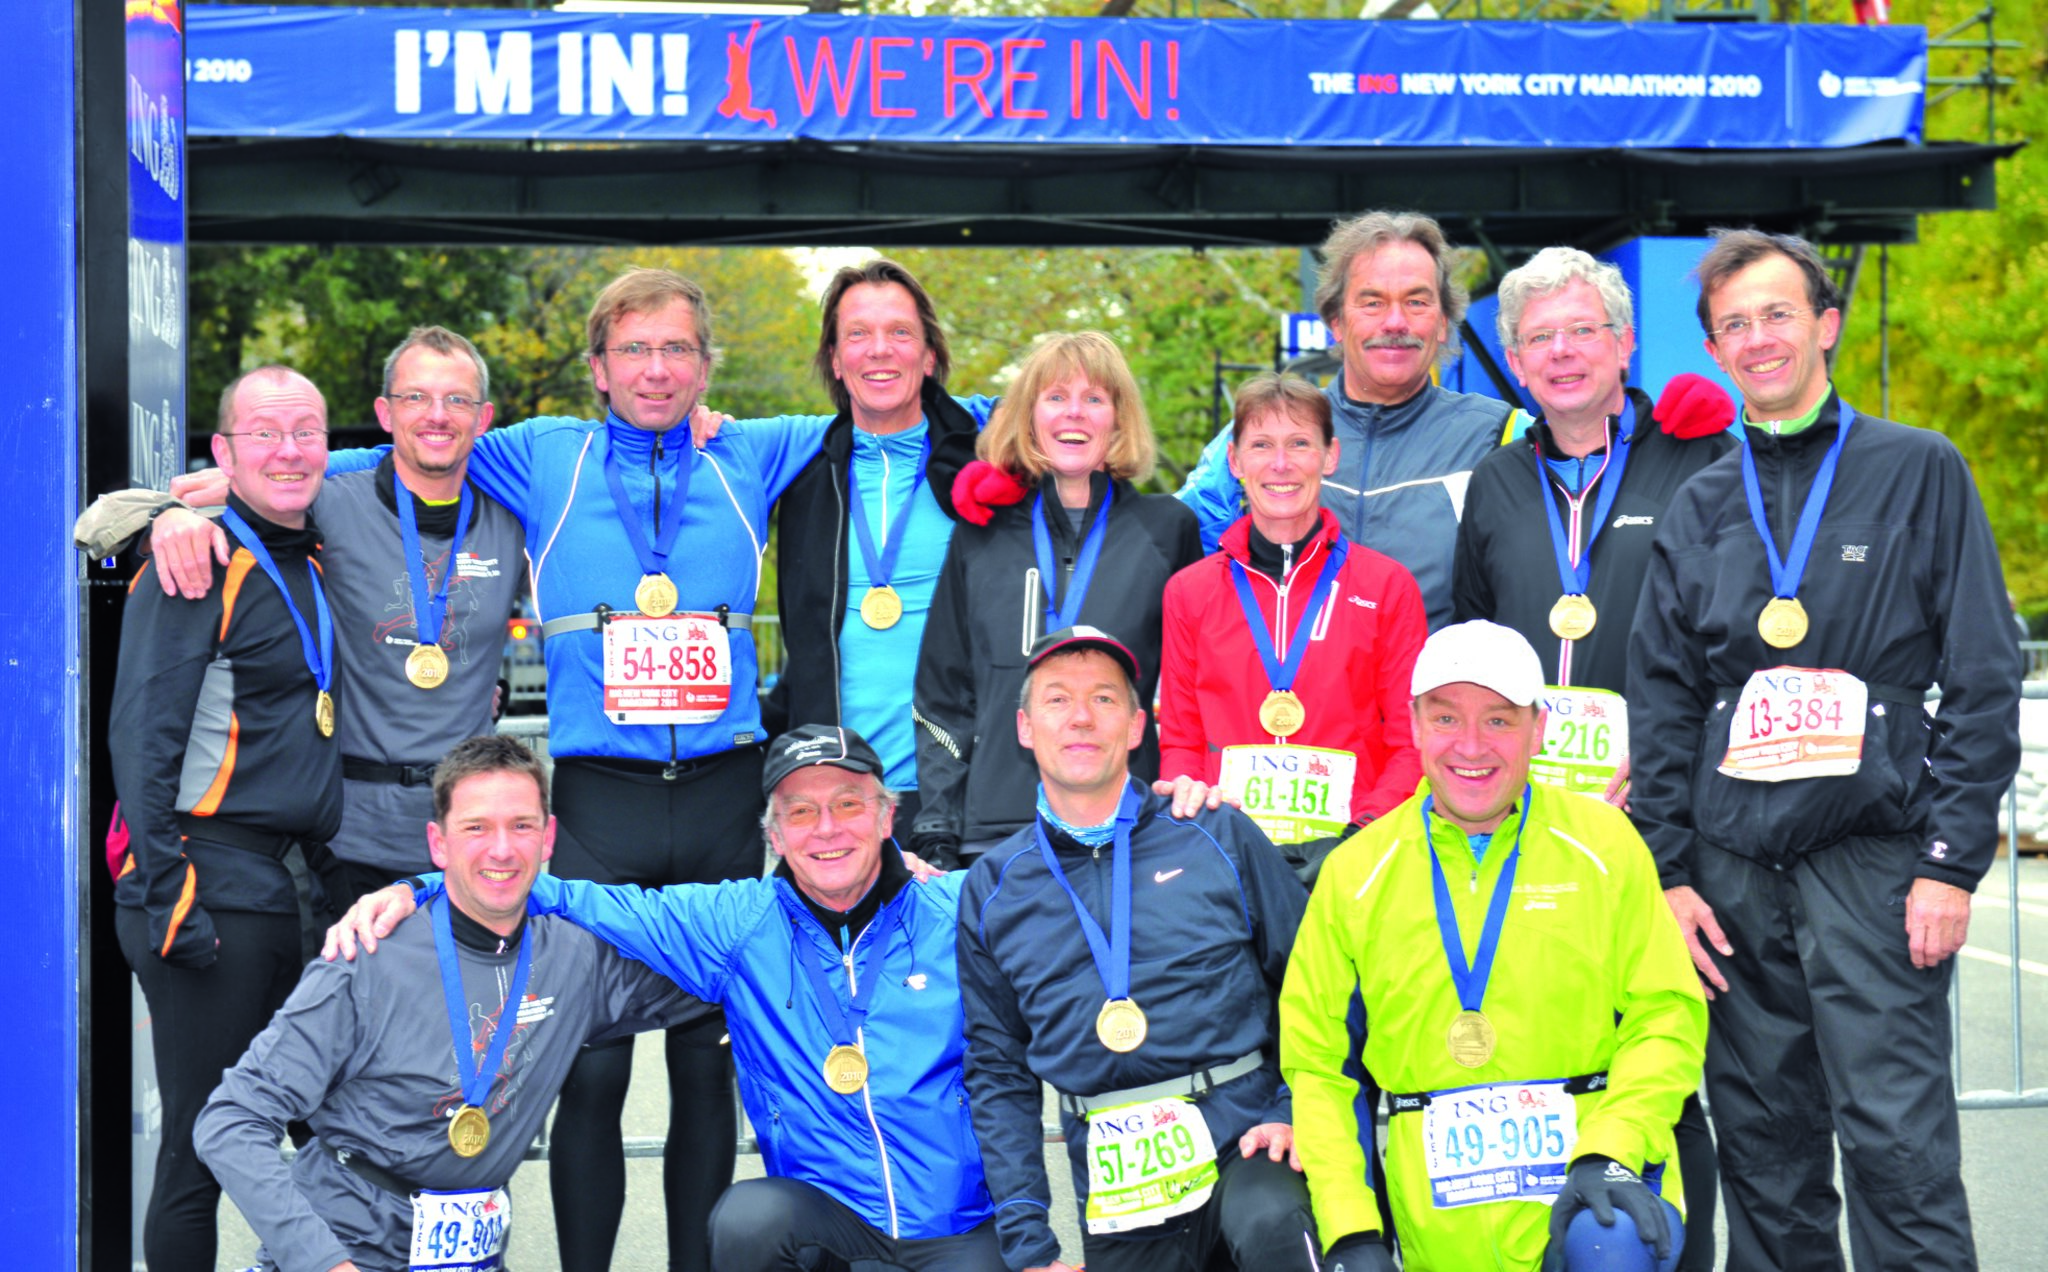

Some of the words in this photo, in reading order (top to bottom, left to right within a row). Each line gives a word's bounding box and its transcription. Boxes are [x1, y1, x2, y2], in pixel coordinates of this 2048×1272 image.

[193, 58, 252, 83] 2010
[395, 29, 533, 115] I'M
[558, 32, 690, 116] IN!
[784, 36, 1048, 119] WE'RE
[1070, 39, 1180, 121] IN!
[1309, 72, 1354, 95] THE
[1358, 74, 1398, 94] ING
[1402, 73, 1457, 95] NEW
[1459, 73, 1522, 96] YORK
[1524, 74, 1578, 96] CITY
[1579, 75, 1706, 97] MARATHON
[1708, 75, 1762, 97] 2010
[632, 625, 679, 642] ING
[623, 645, 718, 681] 54-858
[1749, 697, 1843, 739] 13-384
[1541, 720, 1611, 761] -216
[1251, 755, 1299, 772] ING
[1244, 776, 1331, 816] 61-151
[1454, 1096, 1508, 1118] ING
[1096, 1114, 1144, 1139] ING
[1446, 1114, 1564, 1167] 49-905
[1096, 1124, 1195, 1185] 57-269
